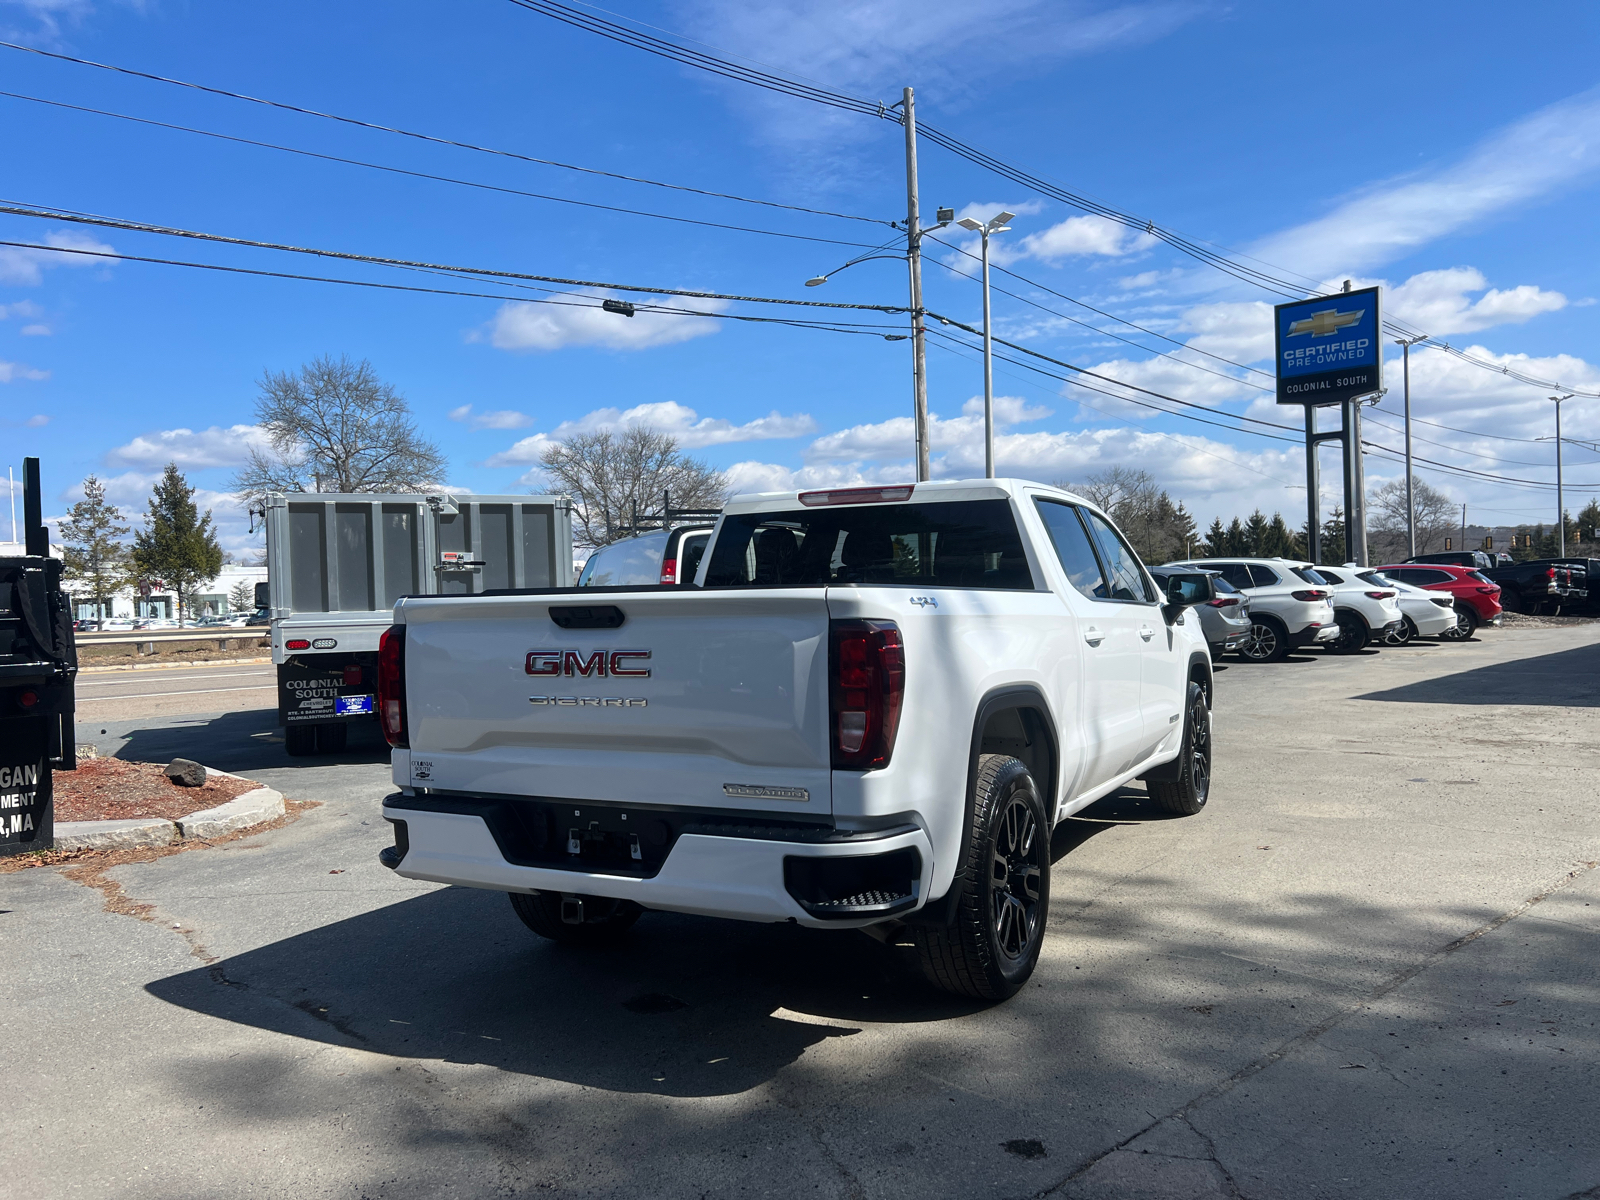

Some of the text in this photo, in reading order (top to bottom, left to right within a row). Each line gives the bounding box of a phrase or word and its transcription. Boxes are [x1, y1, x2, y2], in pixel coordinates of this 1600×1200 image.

[1283, 338, 1369, 360] CERTIFIED
[1288, 349, 1365, 368] PRE-OWNED
[1286, 375, 1367, 394] COLONIAL SOUTH
[525, 650, 651, 677] GMC
[286, 679, 346, 689] COLONIAL
[295, 688, 338, 699] SOUTH
[528, 695, 648, 707] SIERRA
[411, 760, 435, 768] COLONIAL
[0, 764, 37, 788] GAN
[1, 791, 36, 809] MENT
[727, 786, 803, 798] ELEVATION
